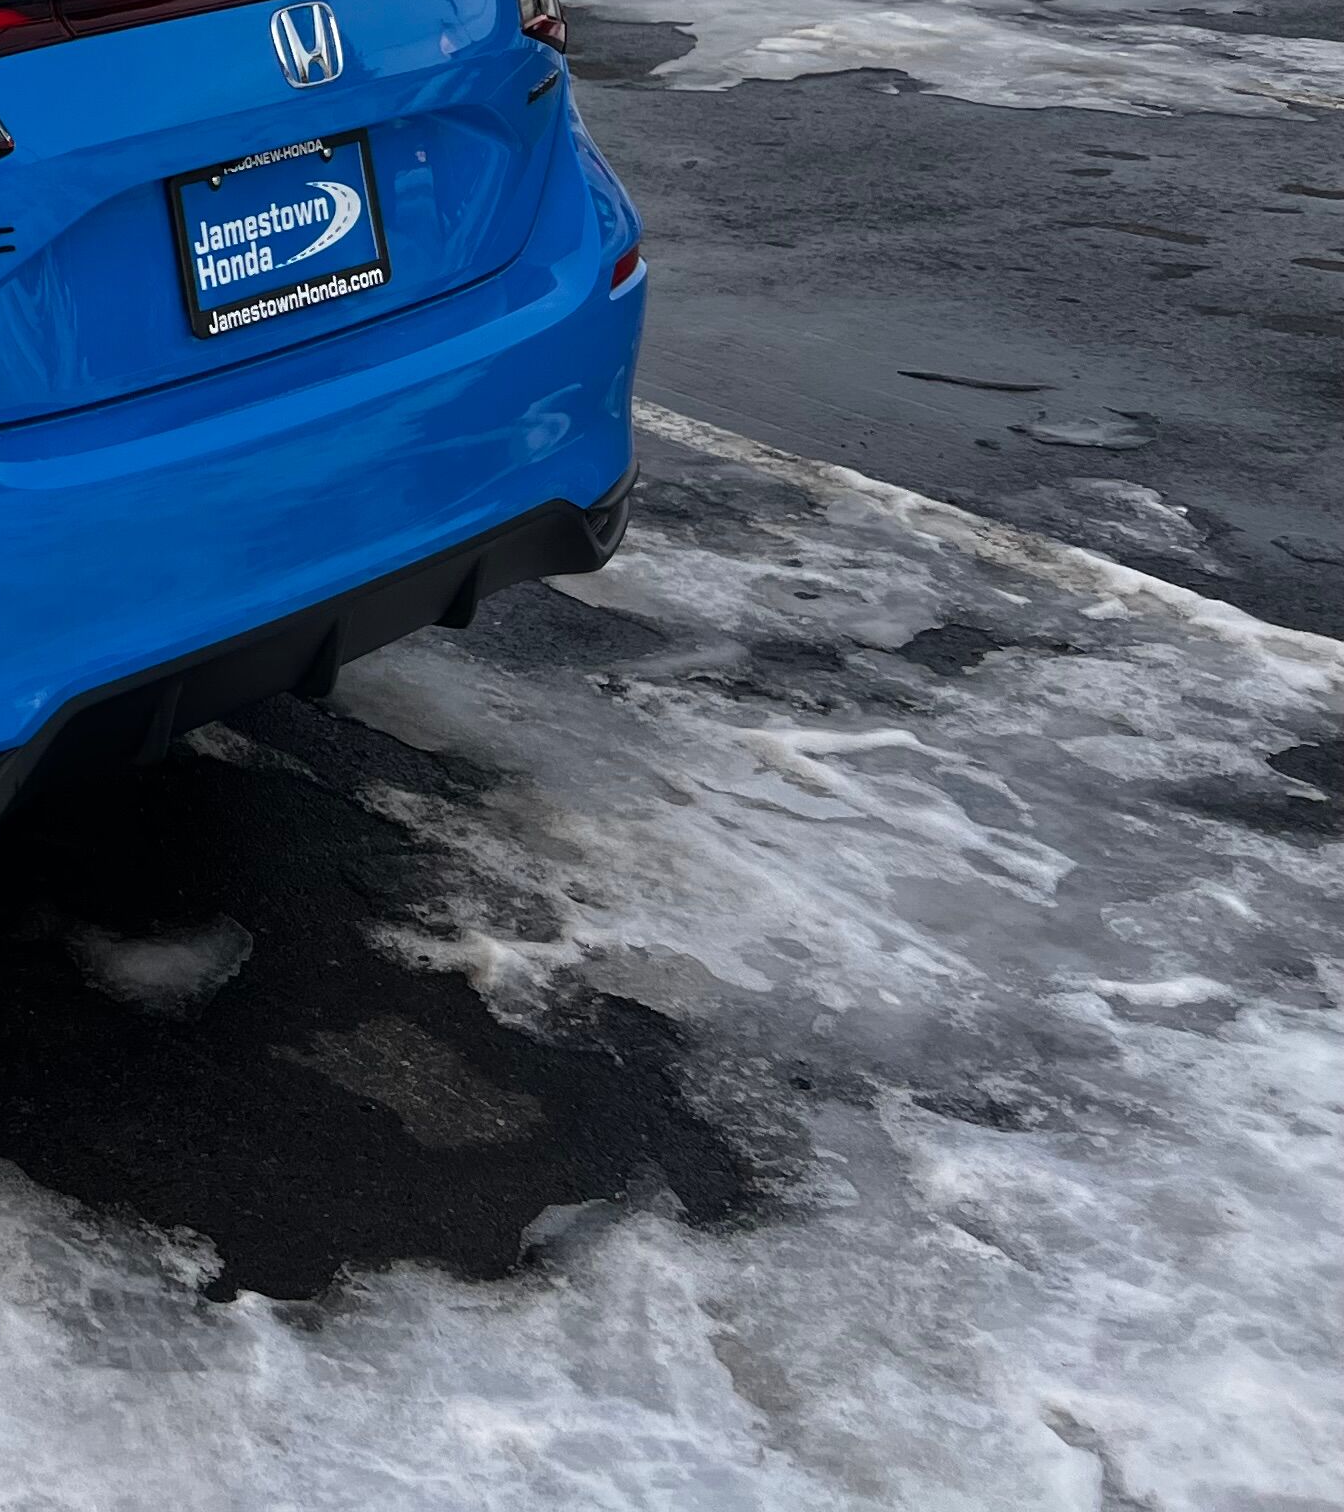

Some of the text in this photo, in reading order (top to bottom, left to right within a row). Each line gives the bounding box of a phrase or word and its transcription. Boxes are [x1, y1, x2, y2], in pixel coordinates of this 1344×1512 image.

[194, 196, 329, 255] Jamestown
[196, 241, 274, 290] Honda
[208, 267, 384, 334] JamestownHonda.com
